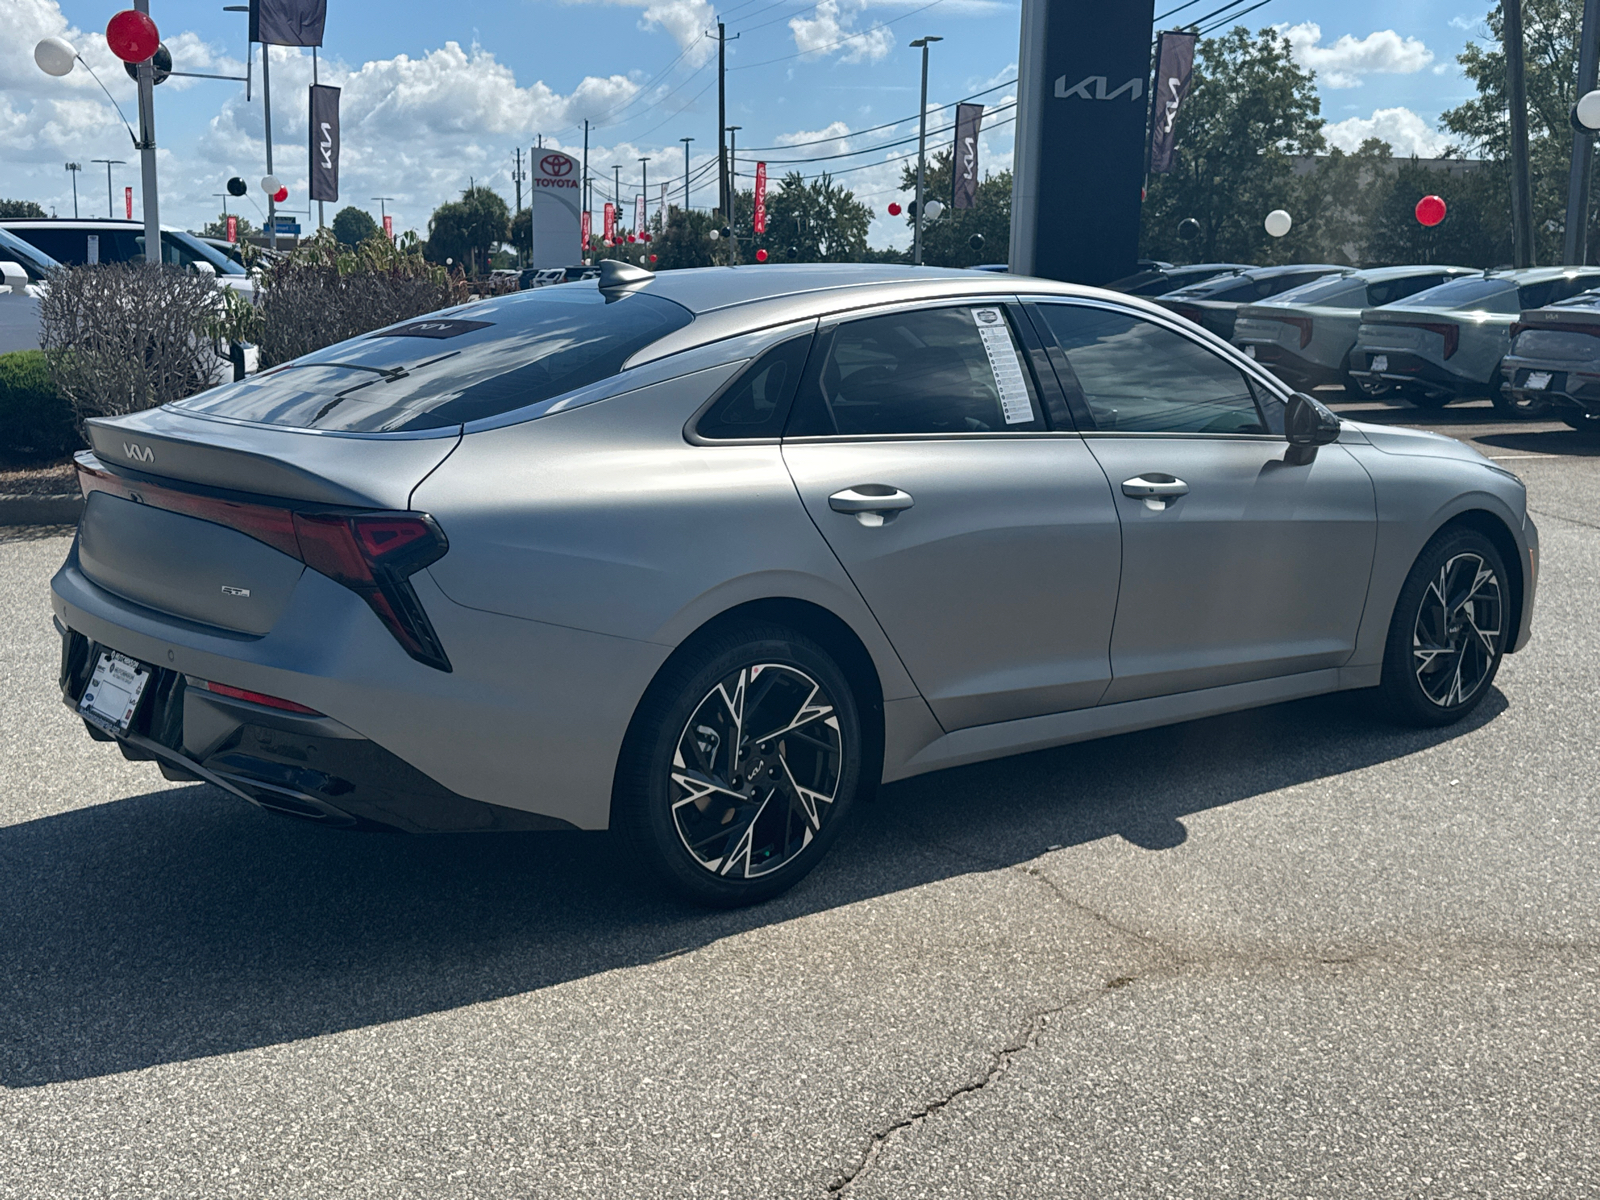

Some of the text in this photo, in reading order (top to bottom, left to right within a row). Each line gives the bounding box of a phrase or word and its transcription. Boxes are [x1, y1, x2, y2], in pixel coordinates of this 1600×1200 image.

[1054, 74, 1143, 101] KIA
[320, 122, 332, 169] KIA
[963, 137, 974, 180] KIA
[534, 178, 578, 189] TOYOTA
[757, 178, 766, 230] TOYOTA
[123, 441, 155, 463] KIA
